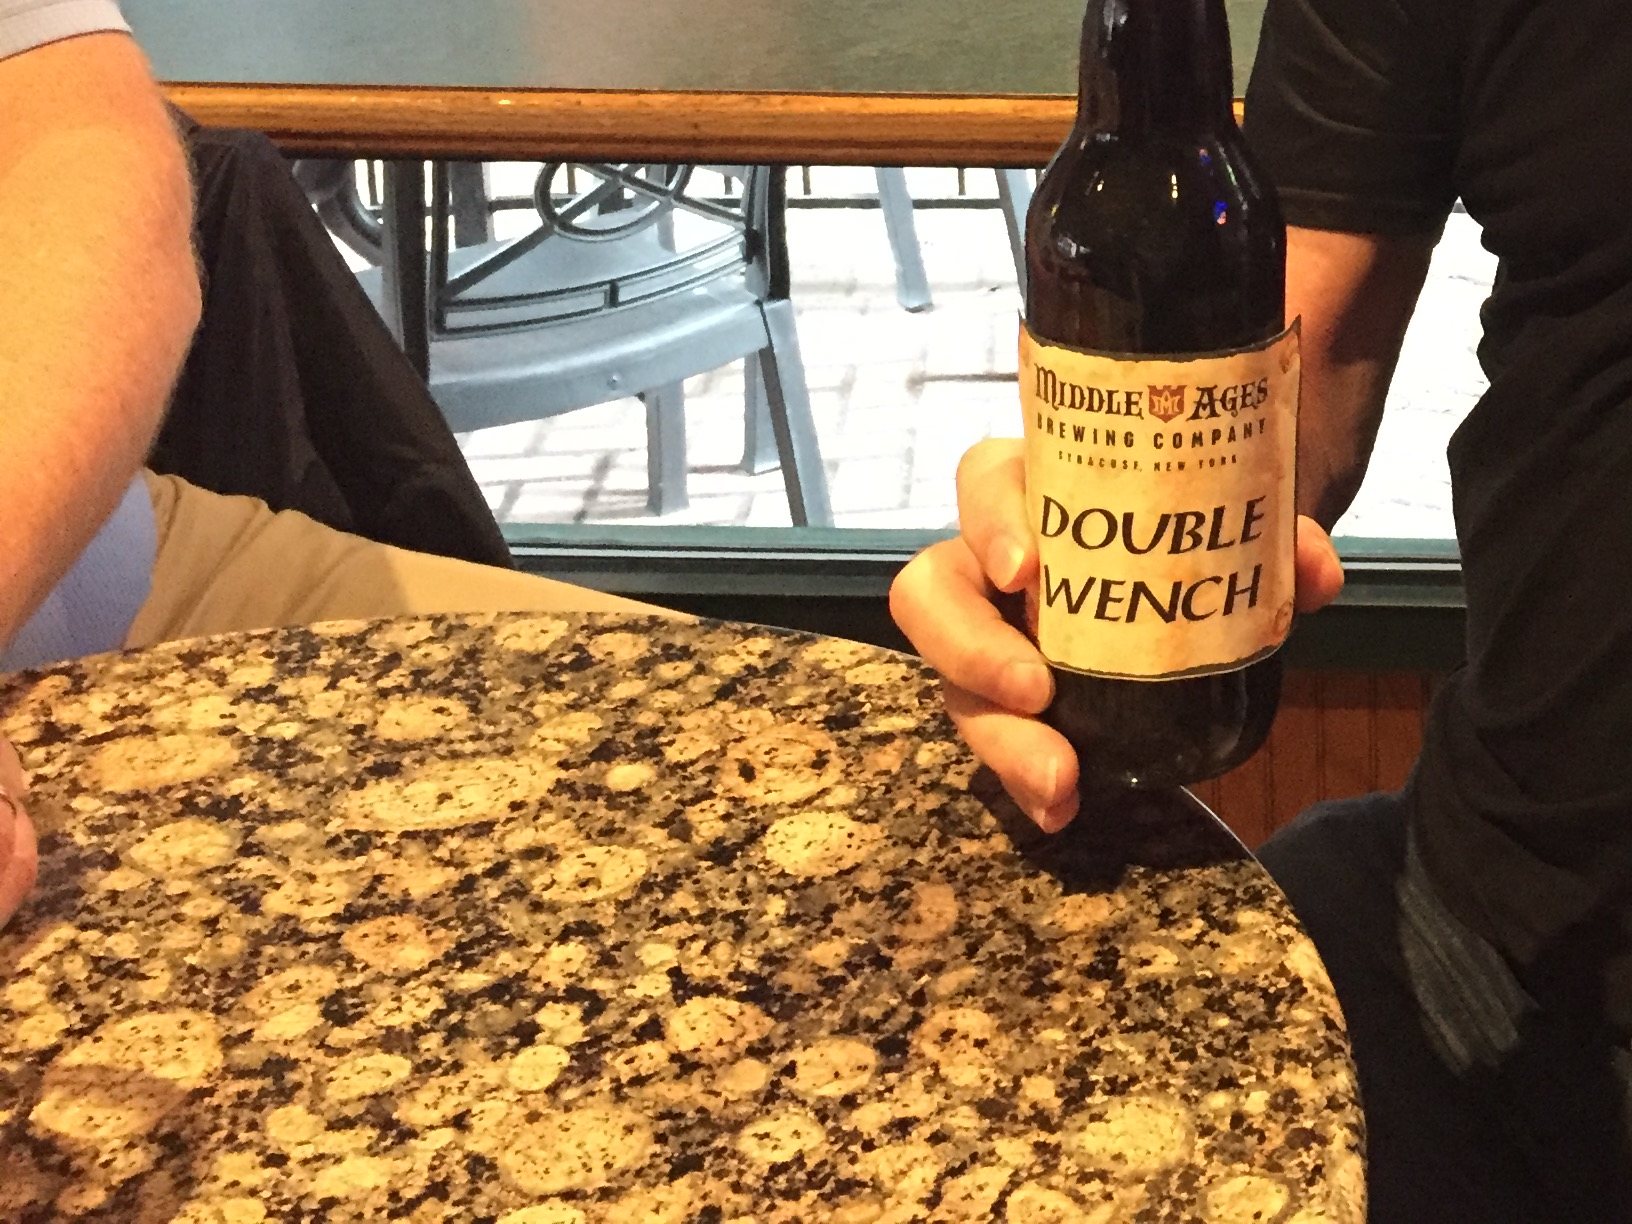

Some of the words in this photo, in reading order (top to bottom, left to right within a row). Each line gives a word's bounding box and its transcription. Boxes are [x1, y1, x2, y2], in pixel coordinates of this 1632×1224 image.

[1034, 363, 1144, 421] MIDDLE
[1185, 377, 1269, 422] AGES
[1036, 411, 1135, 449] BREWING
[1153, 417, 1266, 450] COMPANY
[1154, 460, 1187, 472] NEW
[1198, 454, 1238, 470] YORK
[1040, 494, 1267, 555] DOUBLE
[1043, 563, 1263, 624] WENCH
